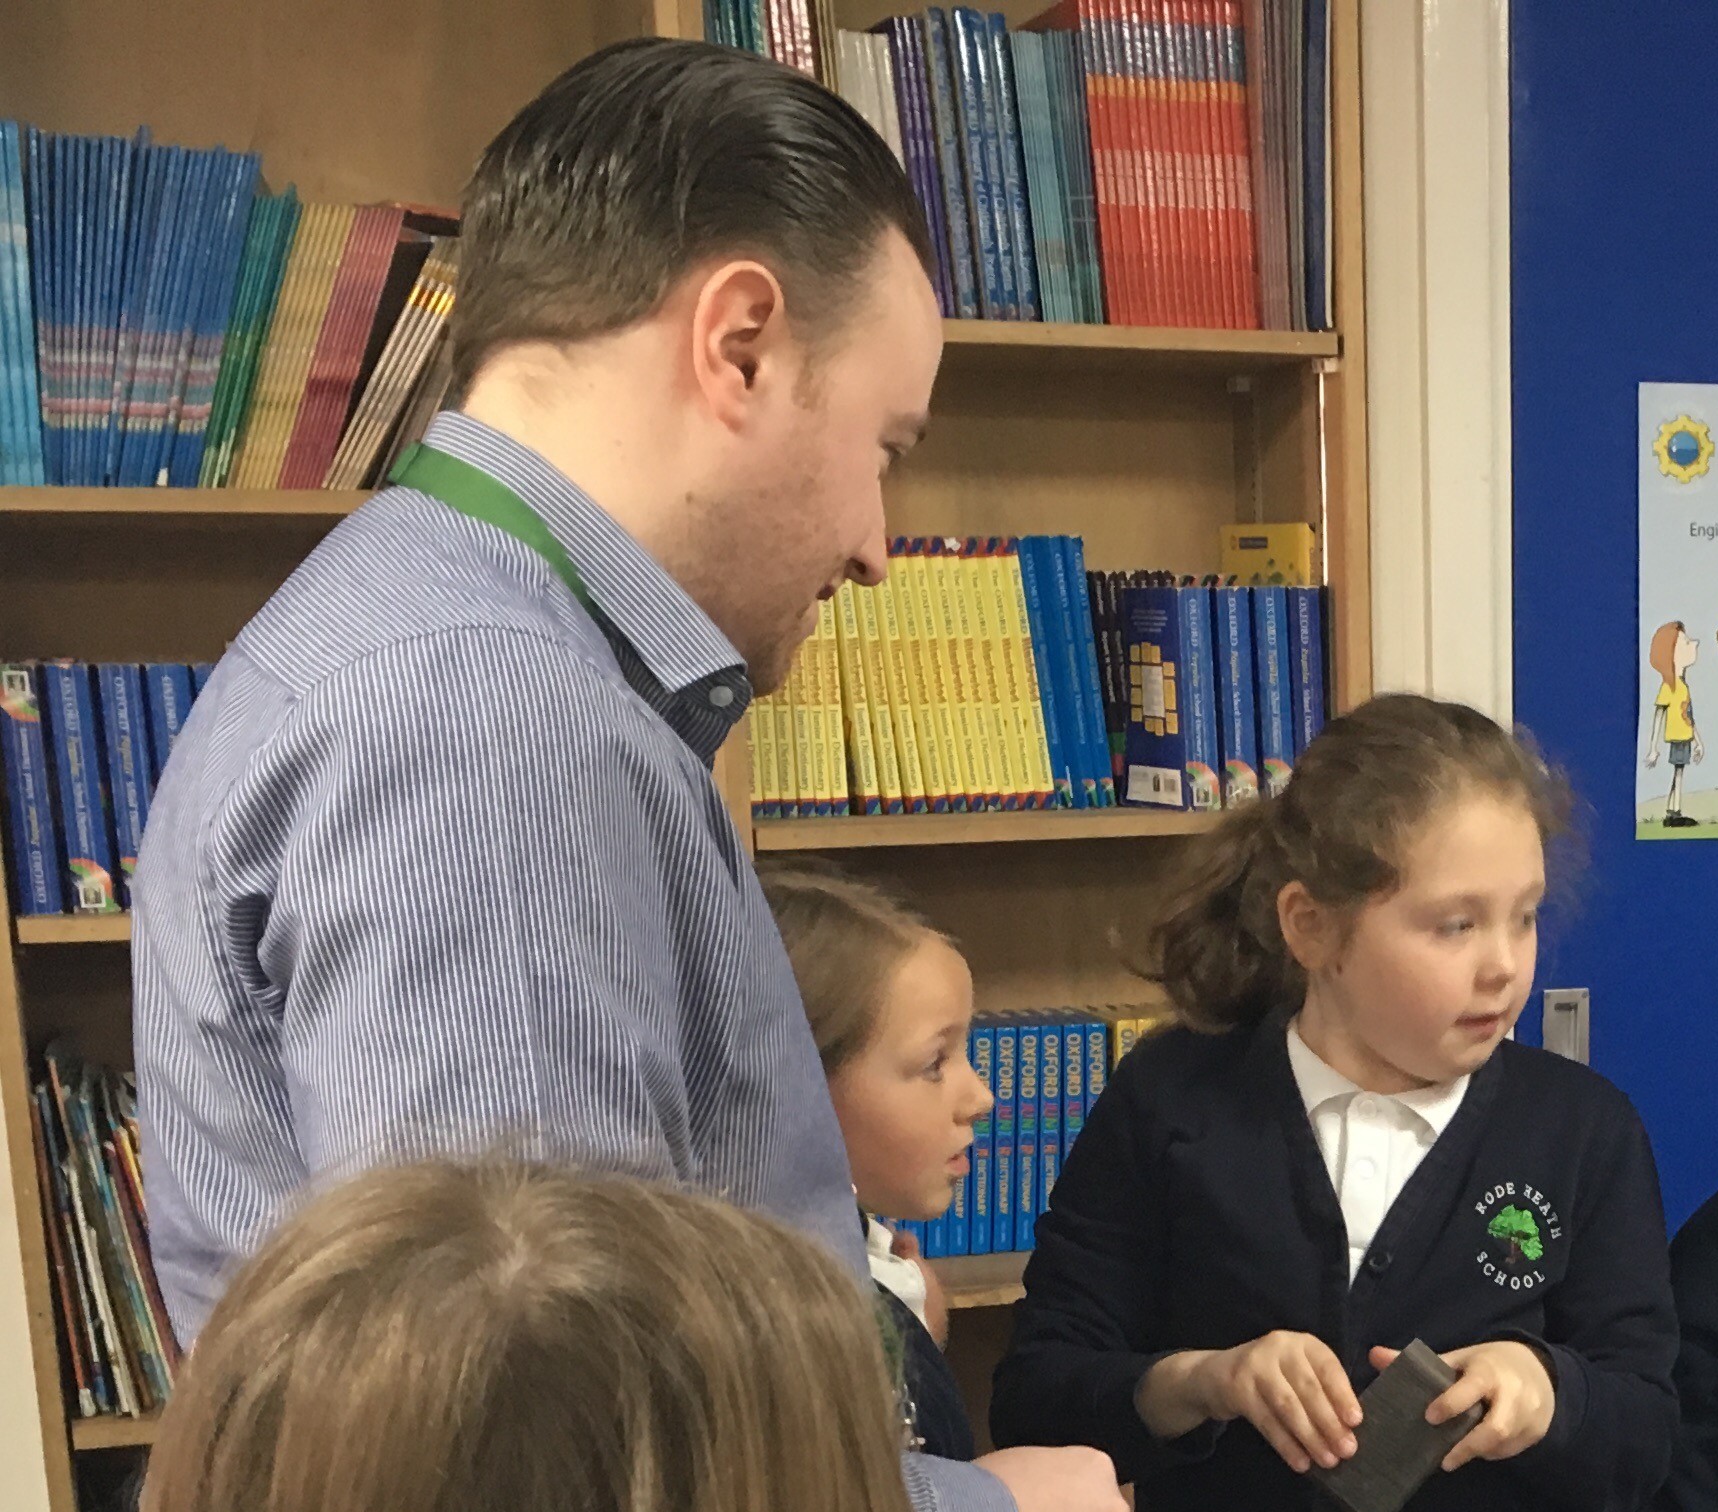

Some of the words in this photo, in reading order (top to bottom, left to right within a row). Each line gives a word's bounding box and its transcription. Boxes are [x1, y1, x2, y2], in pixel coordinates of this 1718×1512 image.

[1188, 598, 1198, 646] OXFORD
[1228, 597, 1237, 646] OXFORD
[1265, 597, 1275, 645] OXFORD
[1298, 596, 1309, 644] OXFORD
[114, 676, 129, 731] OXFORD
[998, 1036, 1014, 1099] OXFORD
[1020, 1035, 1037, 1098] OXFORD
[1042, 1034, 1058, 1097] OXFORD
[1066, 1033, 1081, 1095] OXFORD
[1087, 1032, 1105, 1094] OXFORD
[998, 1103, 1012, 1155] JUNIOR
[1020, 1102, 1035, 1154] JUNIOR
[1043, 1101, 1057, 1154] JUNIOR
[976, 1158, 986, 1215] DICTIONARY
[998, 1157, 1009, 1214] DICTIONARY
[1021, 1156, 1031, 1212] DICTIONARY
[1475, 1182, 1516, 1214] RODE
[1523, 1184, 1562, 1239] HEATH
[1477, 1251, 1545, 1290] SCHOOL
